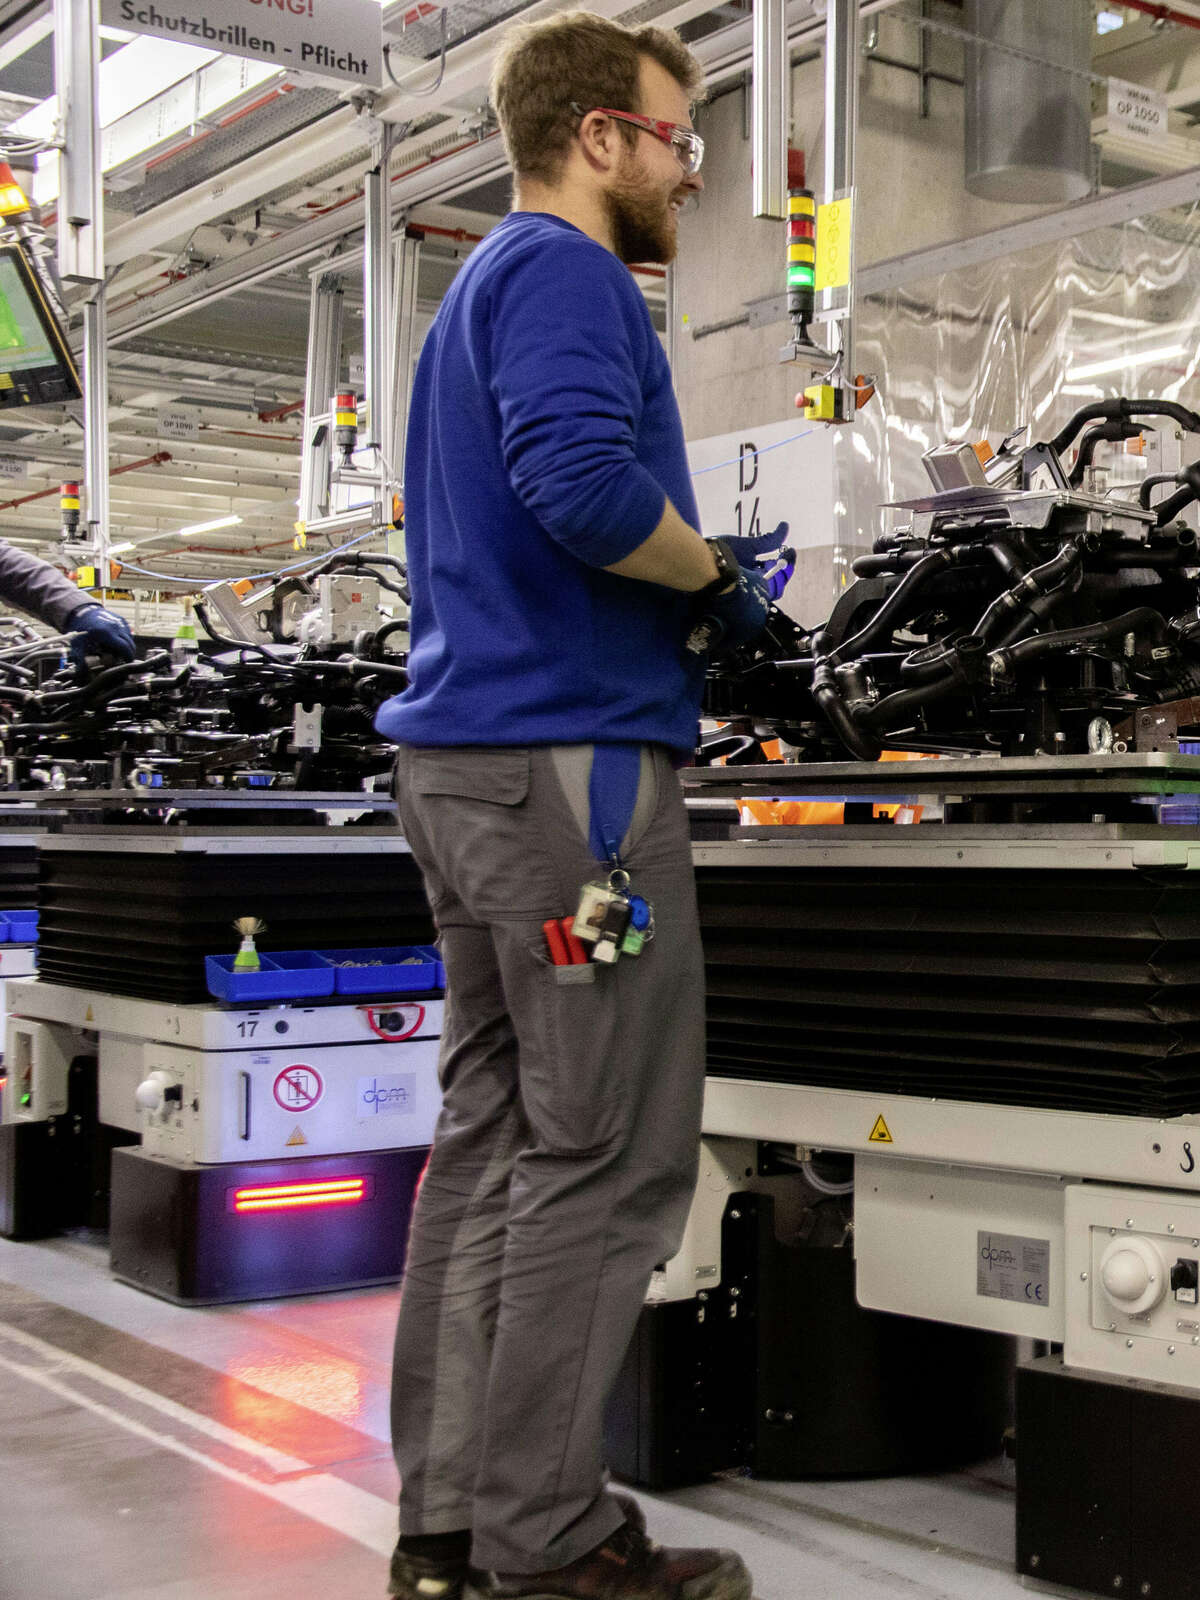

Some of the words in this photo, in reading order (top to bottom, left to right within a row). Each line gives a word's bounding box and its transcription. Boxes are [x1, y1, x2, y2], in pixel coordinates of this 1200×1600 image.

[120, 0, 276, 54] Schutzbrillen
[301, 42, 369, 75] Pflicht
[739, 442, 758, 492] D
[735, 497, 761, 537] 14
[237, 1021, 259, 1038] 17
[363, 1078, 409, 1114] dpm
[981, 1236, 1015, 1272] dpm
